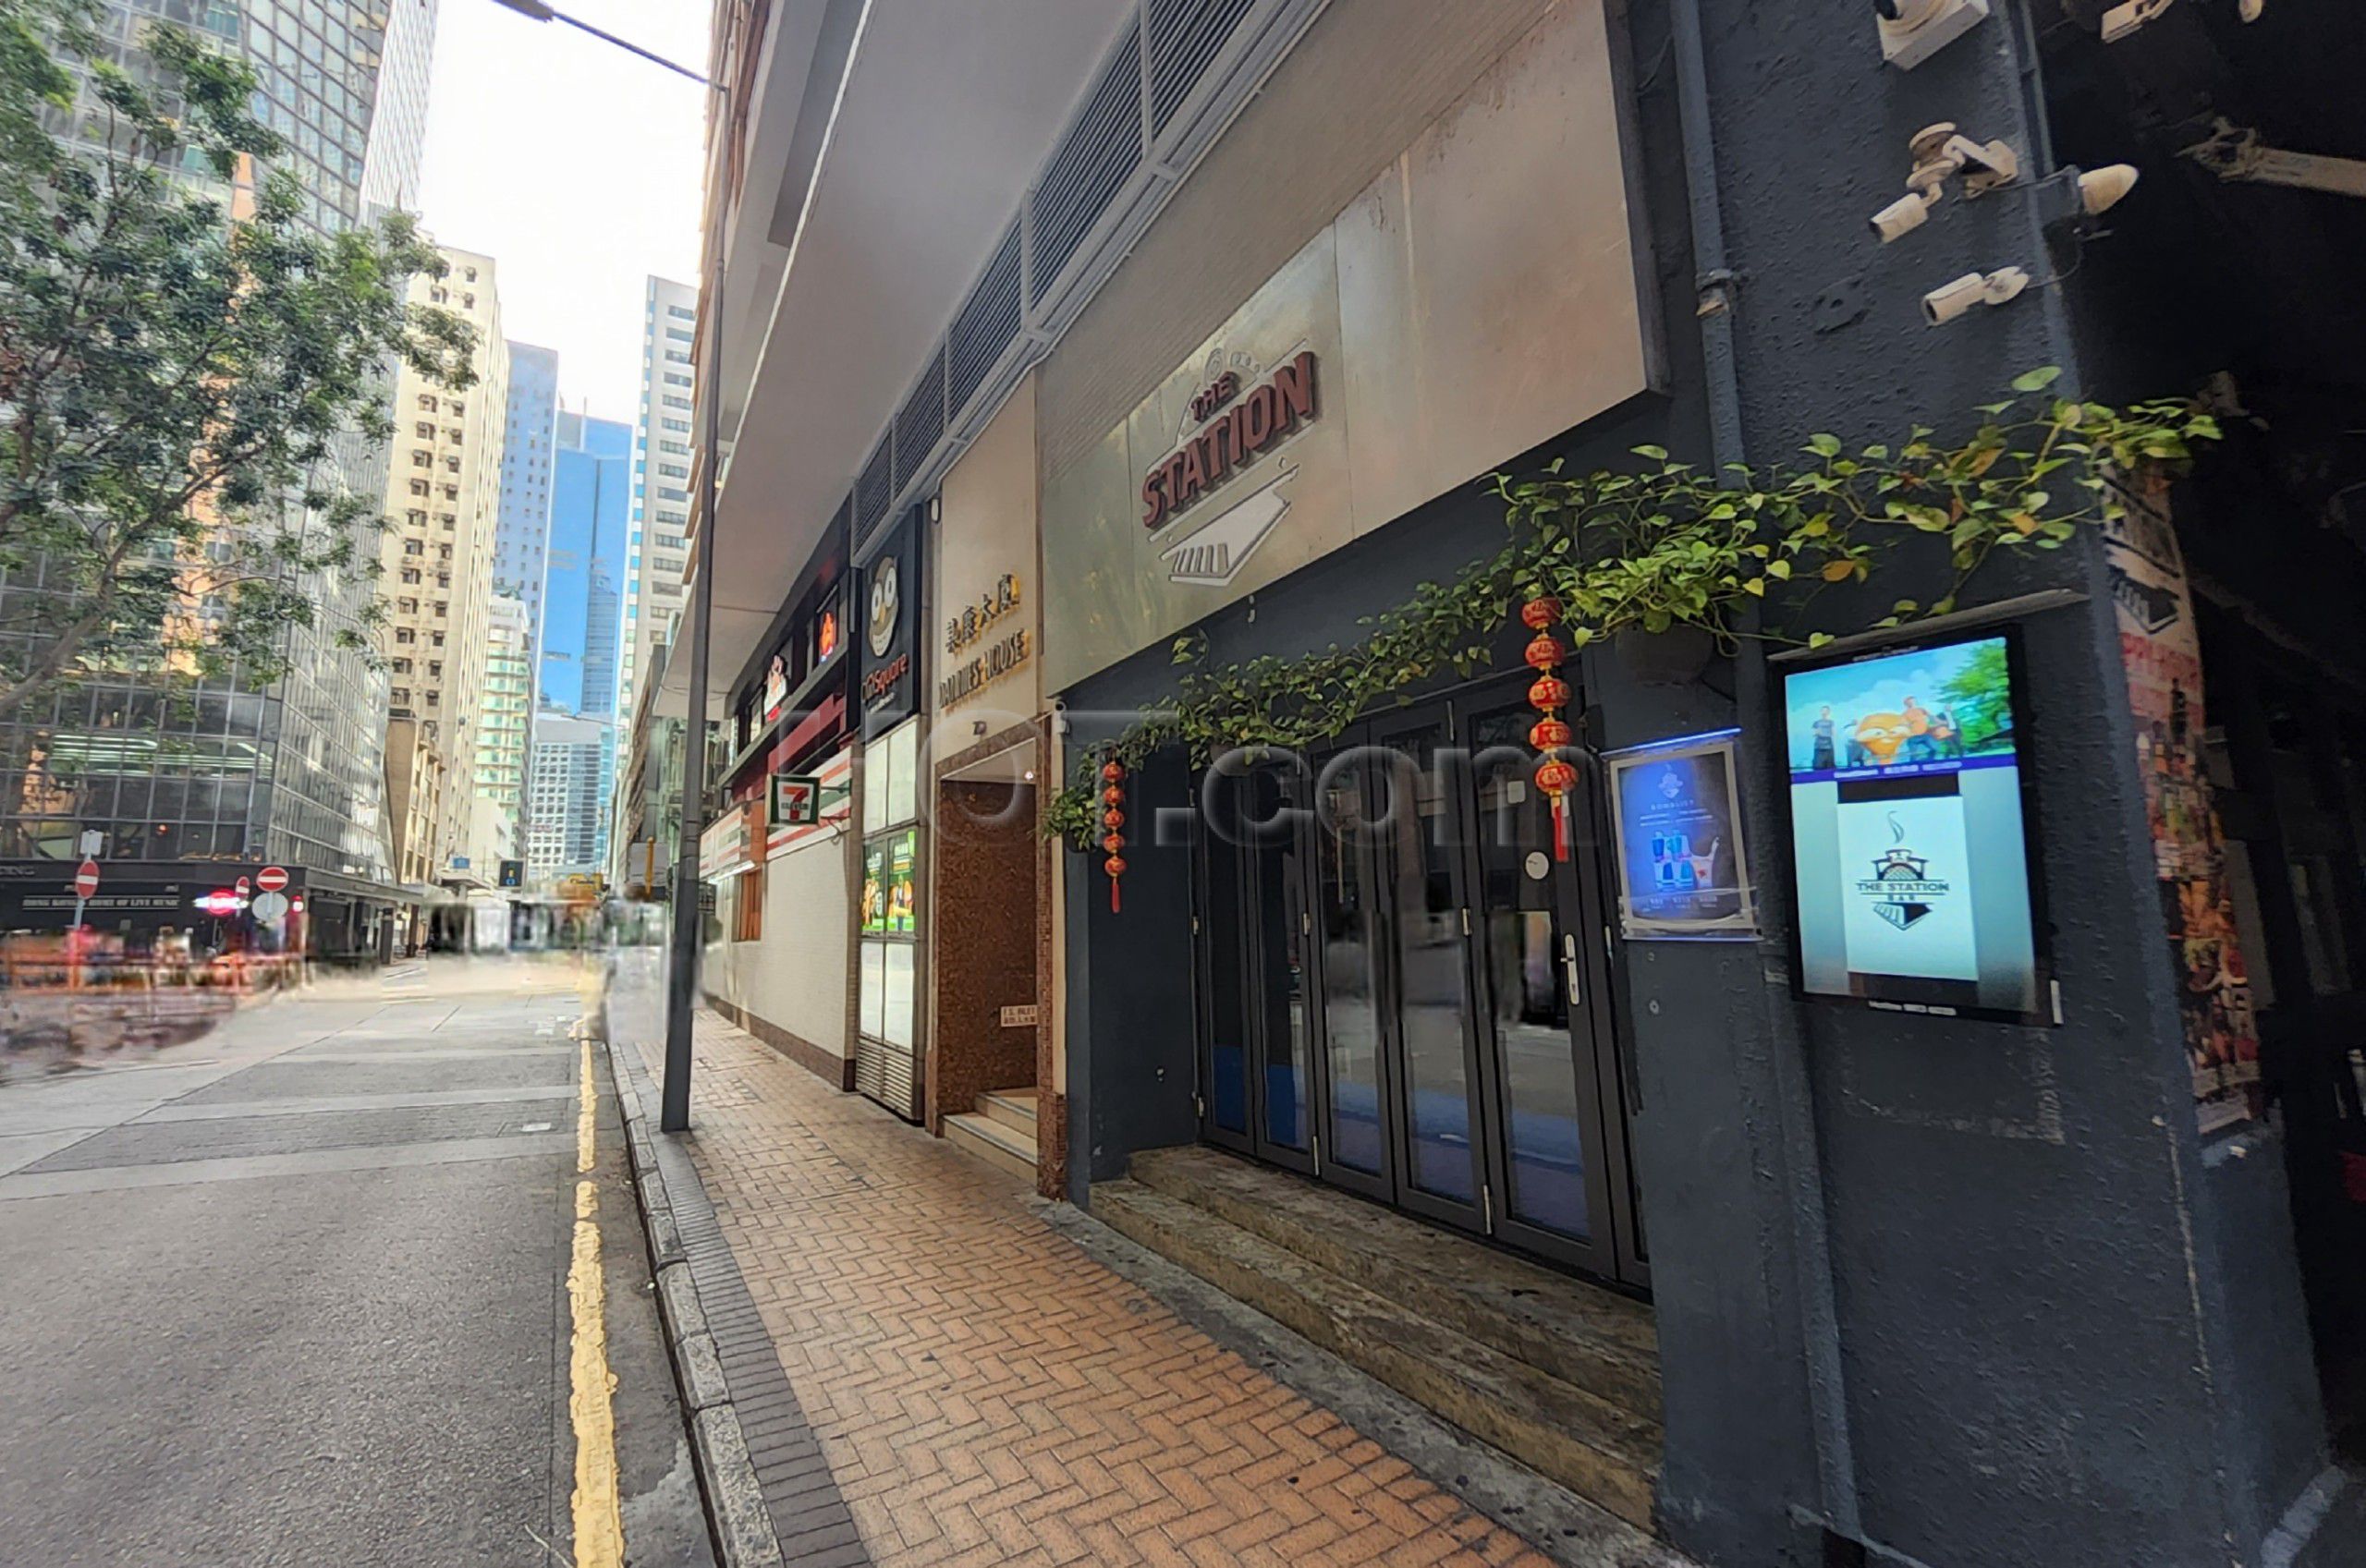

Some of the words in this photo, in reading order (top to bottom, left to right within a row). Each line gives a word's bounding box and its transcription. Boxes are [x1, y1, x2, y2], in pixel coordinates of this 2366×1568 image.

[1191, 371, 1237, 421] THE
[1142, 351, 1317, 528] STATION
[984, 628, 1027, 681] HOUSE
[1856, 882, 1884, 892] THE
[1887, 882, 1949, 892] STATION
